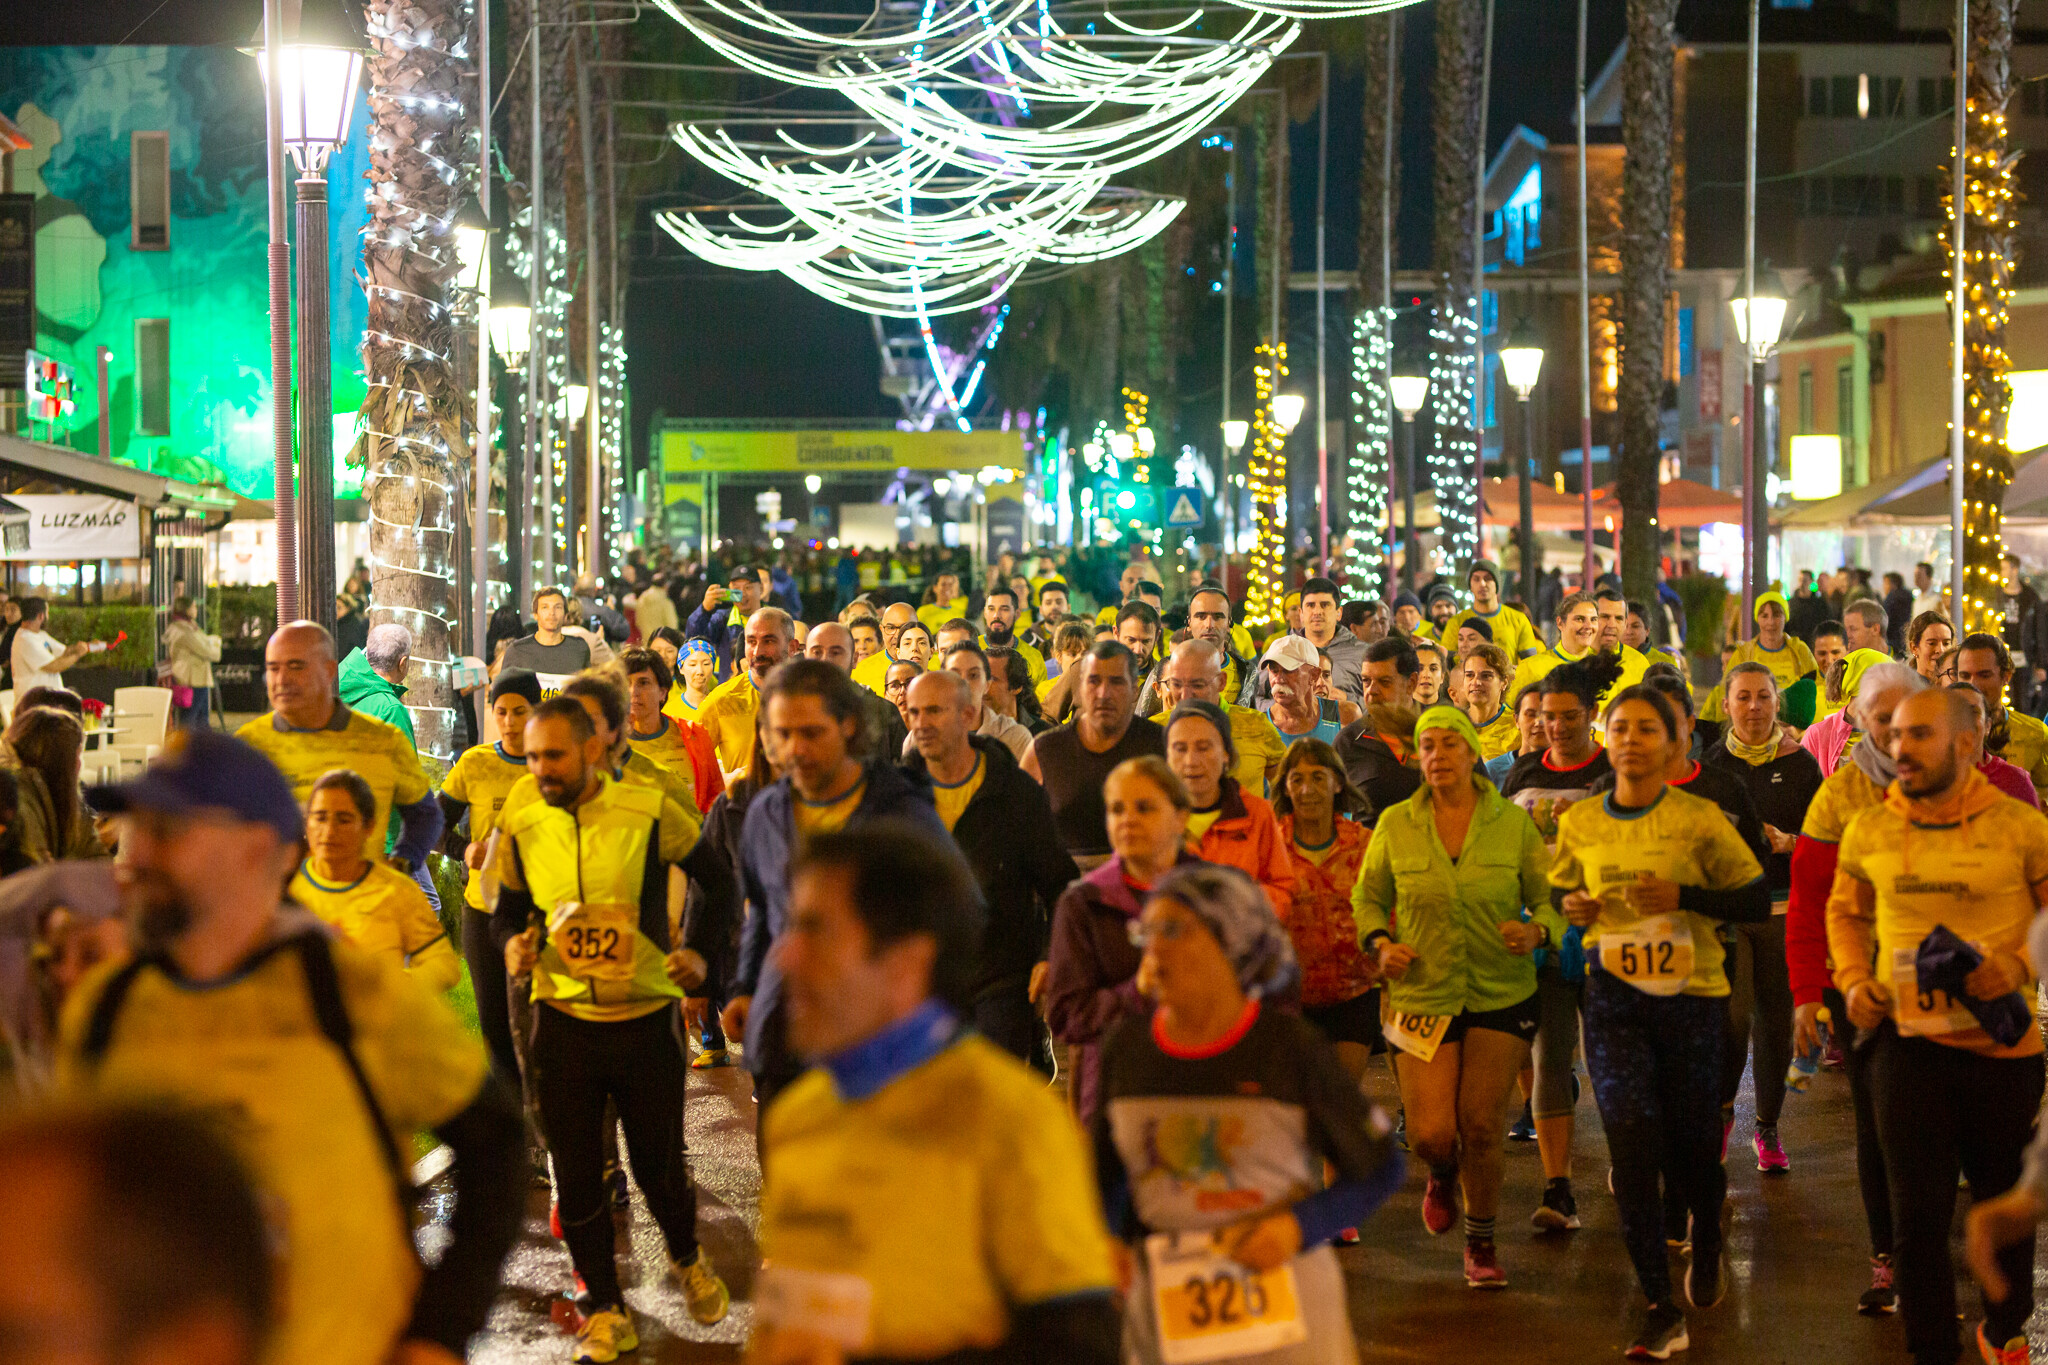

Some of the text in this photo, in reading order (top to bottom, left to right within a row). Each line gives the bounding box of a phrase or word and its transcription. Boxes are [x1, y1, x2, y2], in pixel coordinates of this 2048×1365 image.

[41, 511, 126, 528] LUZMAR
[567, 927, 619, 959] 352
[1621, 941, 1675, 975] 512
